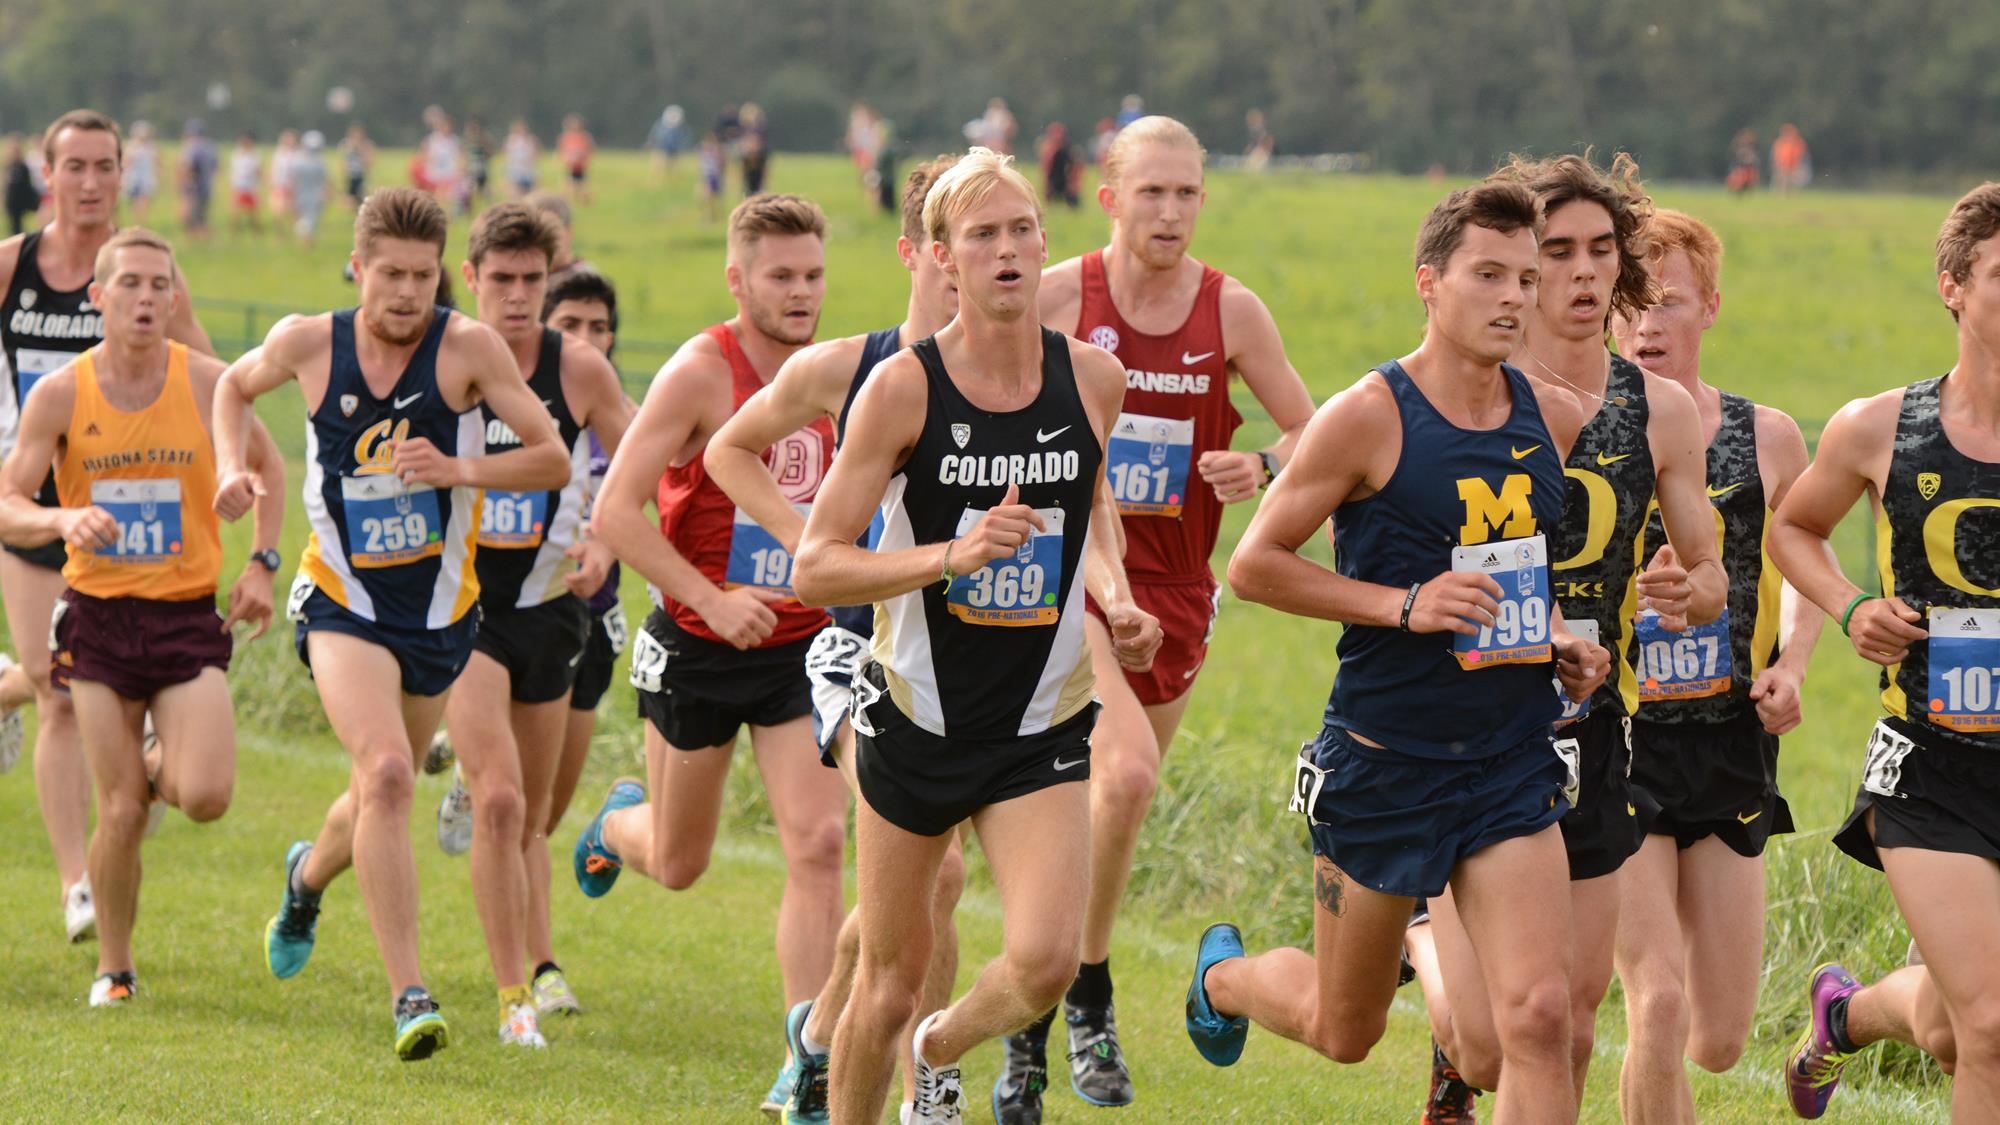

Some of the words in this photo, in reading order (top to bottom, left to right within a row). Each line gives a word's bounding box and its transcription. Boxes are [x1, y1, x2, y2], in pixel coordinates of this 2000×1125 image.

[82, 451, 142, 472] ARIZONA
[147, 448, 195, 466] STATE
[938, 450, 1079, 487] COLORADO
[1111, 462, 1170, 503] 161
[1456, 474, 1537, 546] M
[116, 520, 163, 555] 141
[362, 512, 429, 553] 259
[751, 548, 797, 586] 19
[967, 564, 1044, 608] 369
